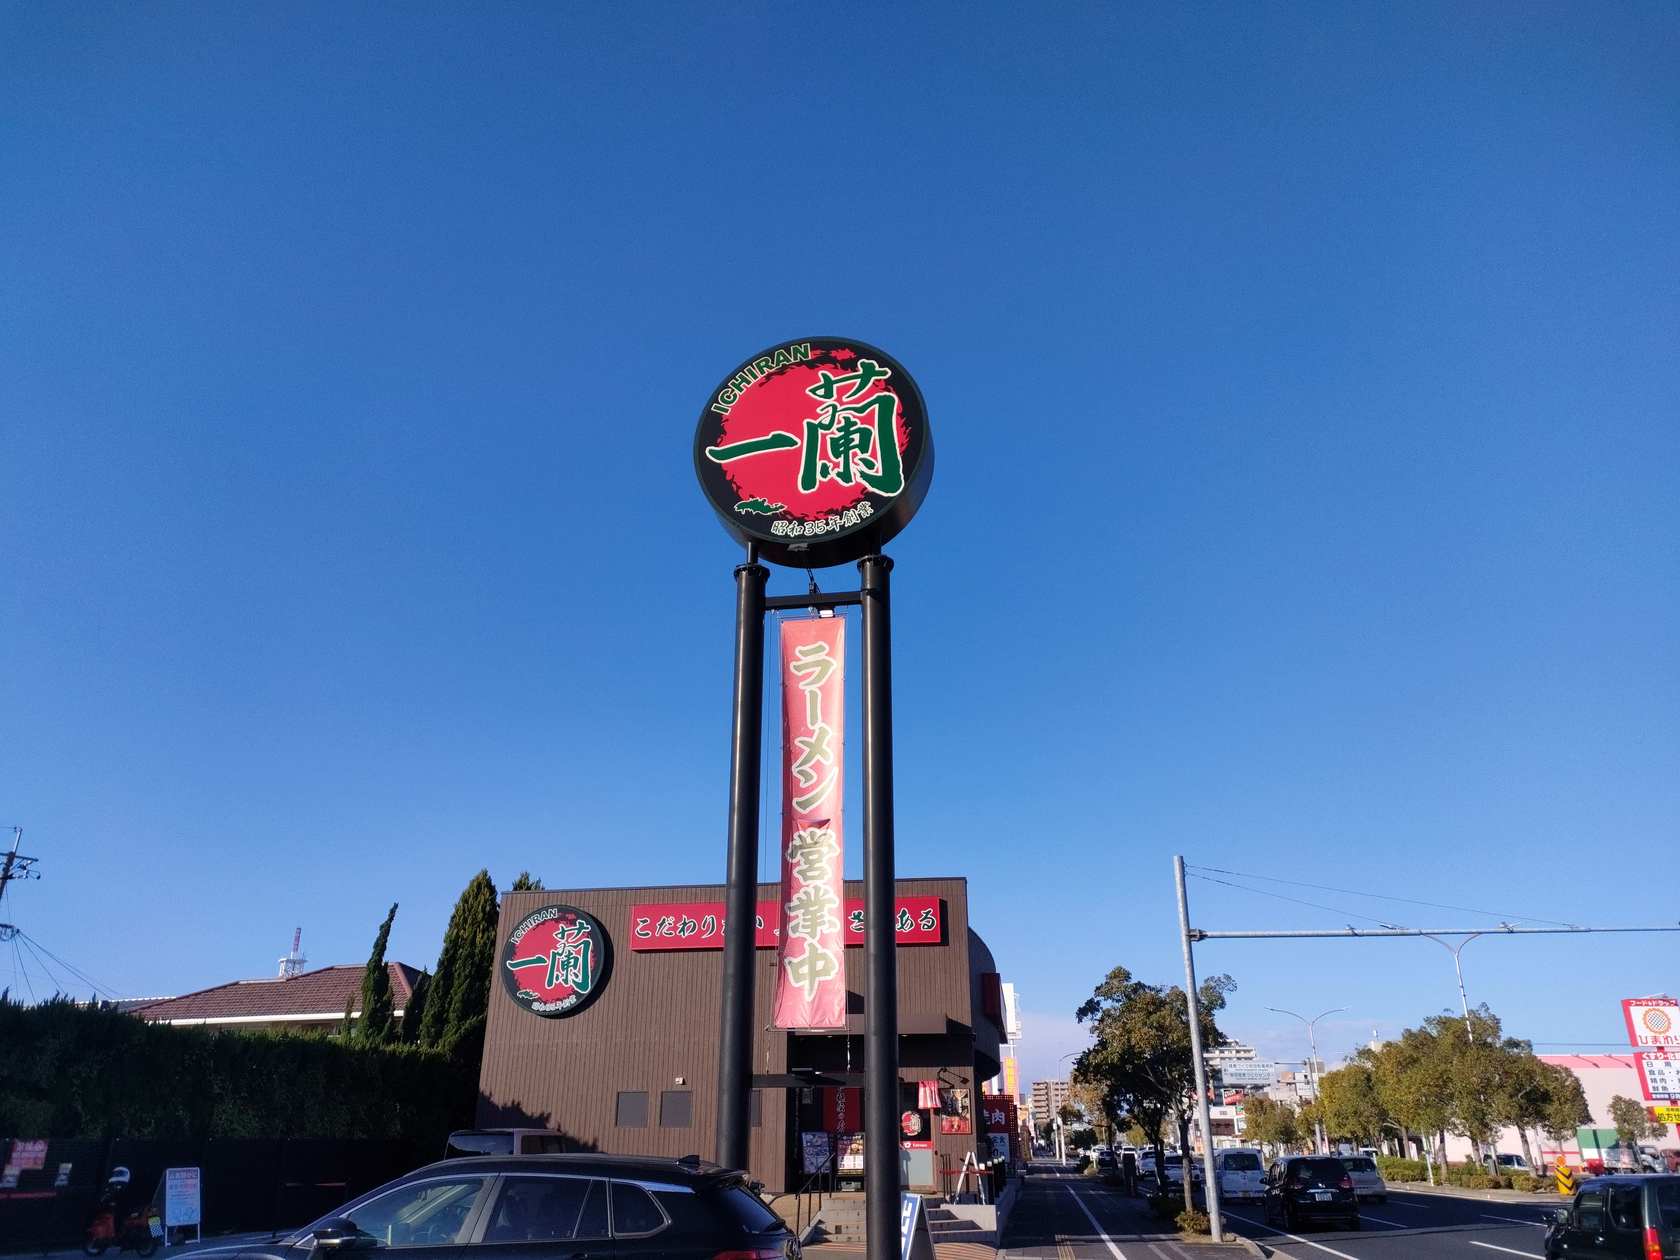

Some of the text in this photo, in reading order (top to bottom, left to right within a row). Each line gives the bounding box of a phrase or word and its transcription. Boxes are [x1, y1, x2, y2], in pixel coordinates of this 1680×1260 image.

[711, 342, 812, 415] ICHIRAN
[705, 358, 905, 497] 一蘭
[771, 501, 874, 537] 昭和35年創業
[506, 920, 593, 994] 一蘭
[510, 908, 558, 945] ICHIRAN
